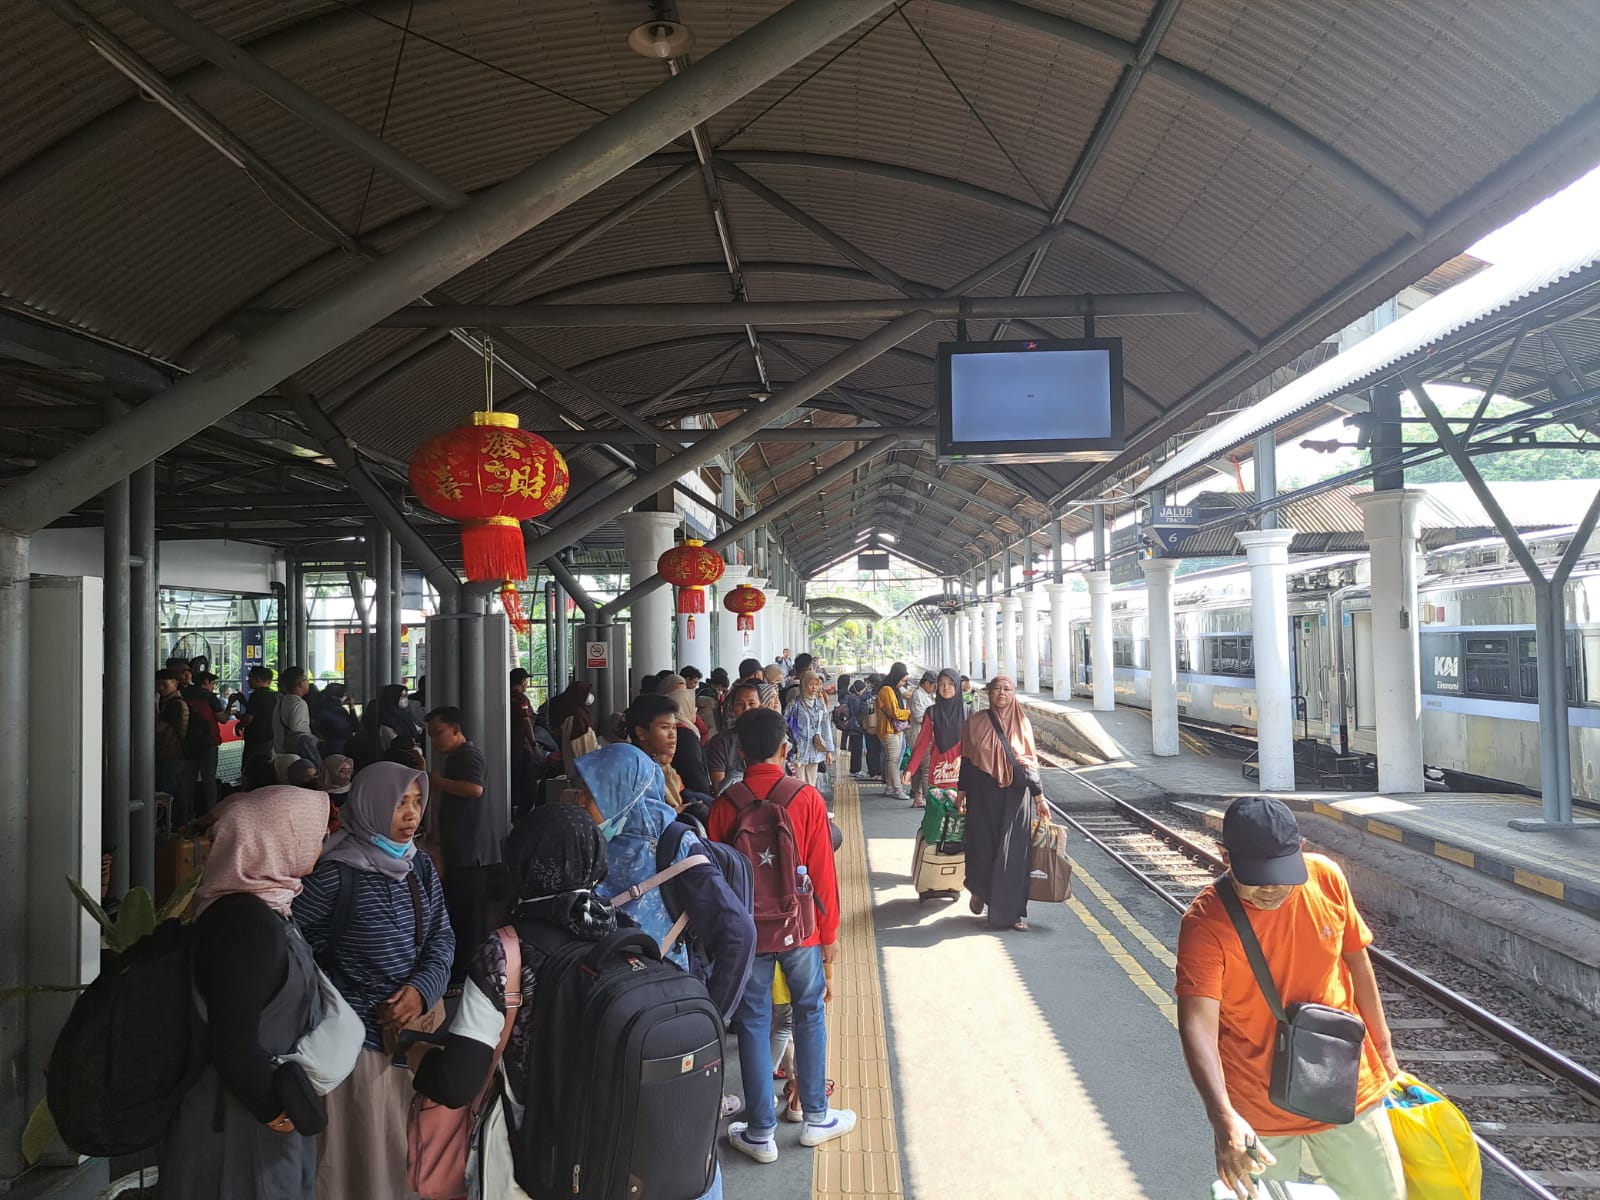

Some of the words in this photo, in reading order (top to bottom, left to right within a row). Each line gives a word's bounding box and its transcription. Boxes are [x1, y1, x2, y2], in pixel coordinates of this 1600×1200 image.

[1160, 507, 1193, 517] JALUR
[1168, 532, 1178, 543] 6
[1434, 655, 1459, 677] KAI
